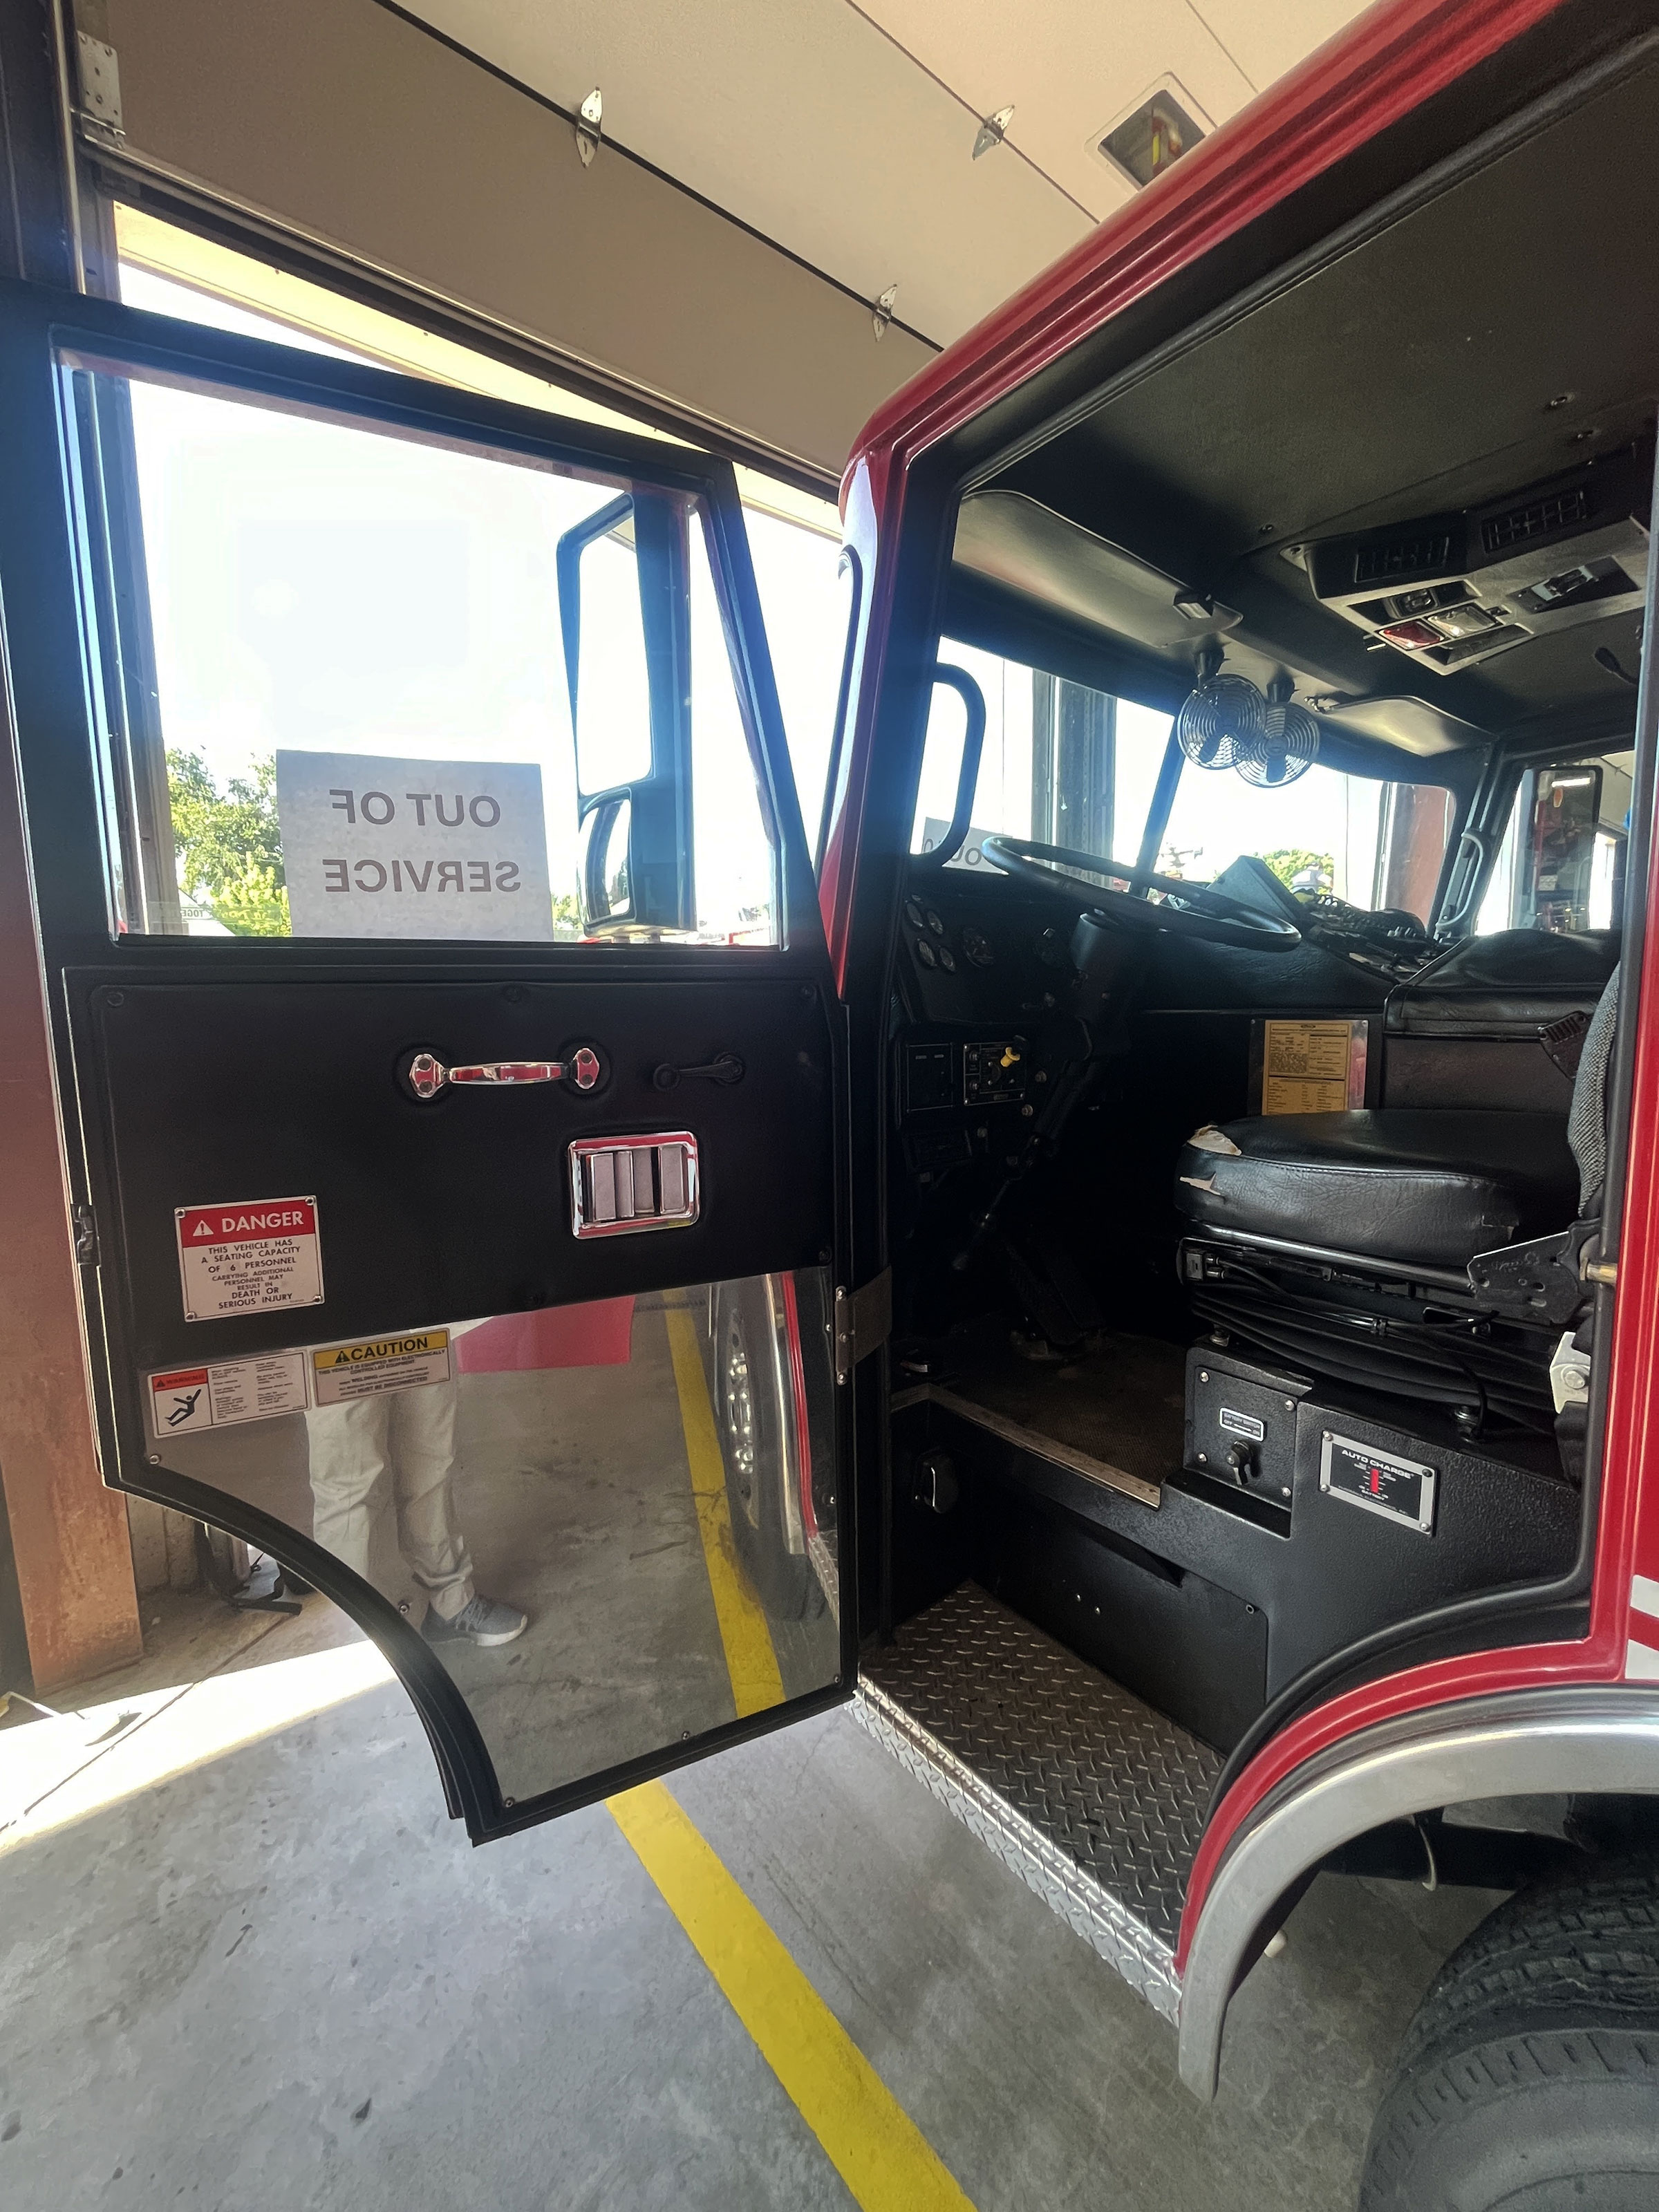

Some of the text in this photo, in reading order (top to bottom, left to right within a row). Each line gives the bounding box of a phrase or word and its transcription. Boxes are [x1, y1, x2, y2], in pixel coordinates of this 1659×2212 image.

[221, 1210, 304, 1233] DANGER
[208, 1239, 292, 1255] THIS VEHICLE HAS
[214, 1252, 253, 1262] SEATING
[259, 1246, 300, 1257] CAPACITY
[245, 1257, 297, 1268] PERSONNEL
[212, 1266, 294, 1282] CARRYING ADDITIONAL
[224, 1277, 264, 1286] PERSONNEL
[232, 1289, 261, 1300] DEATH
[237, 1282, 261, 1291] RESULT
[218, 1293, 292, 1309] SERIOUS INJURY
[350, 1337, 429, 1360] CAUTION
[1342, 1450, 1369, 1463] AUTO
